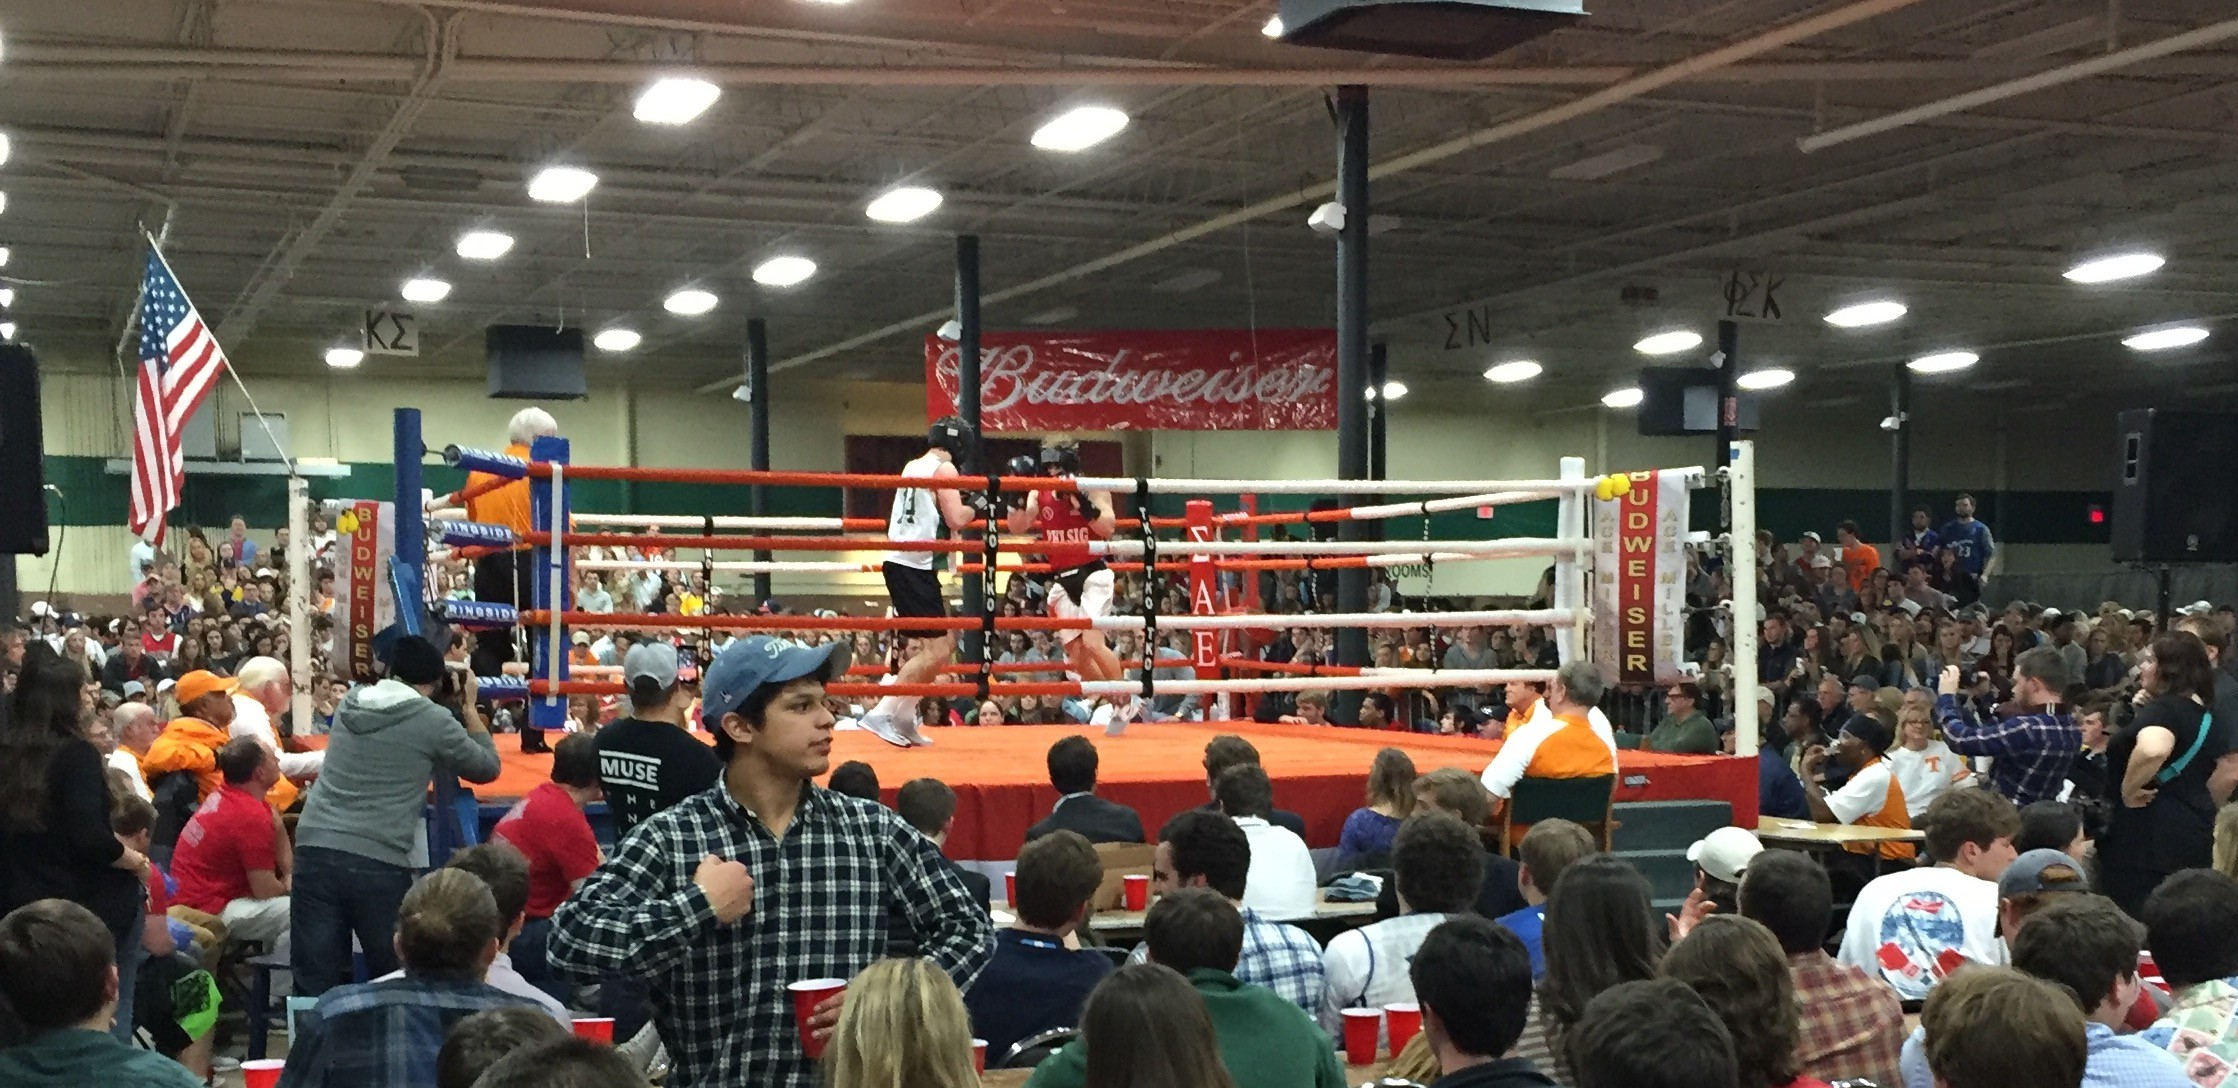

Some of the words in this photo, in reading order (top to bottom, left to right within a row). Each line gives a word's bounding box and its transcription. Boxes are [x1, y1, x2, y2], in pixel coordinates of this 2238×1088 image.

[939, 344, 1333, 412] Budweiser
[988, 503, 997, 549] TKO
[1138, 506, 1155, 550] TKO
[353, 507, 374, 677] BUDWEISER
[986, 565, 996, 612] TKO
[1144, 565, 1154, 610] TKO
[981, 630, 992, 674] TKO
[1144, 626, 1155, 671] TKO
[600, 757, 659, 784] MUSE
[1925, 756, 1941, 772] T
